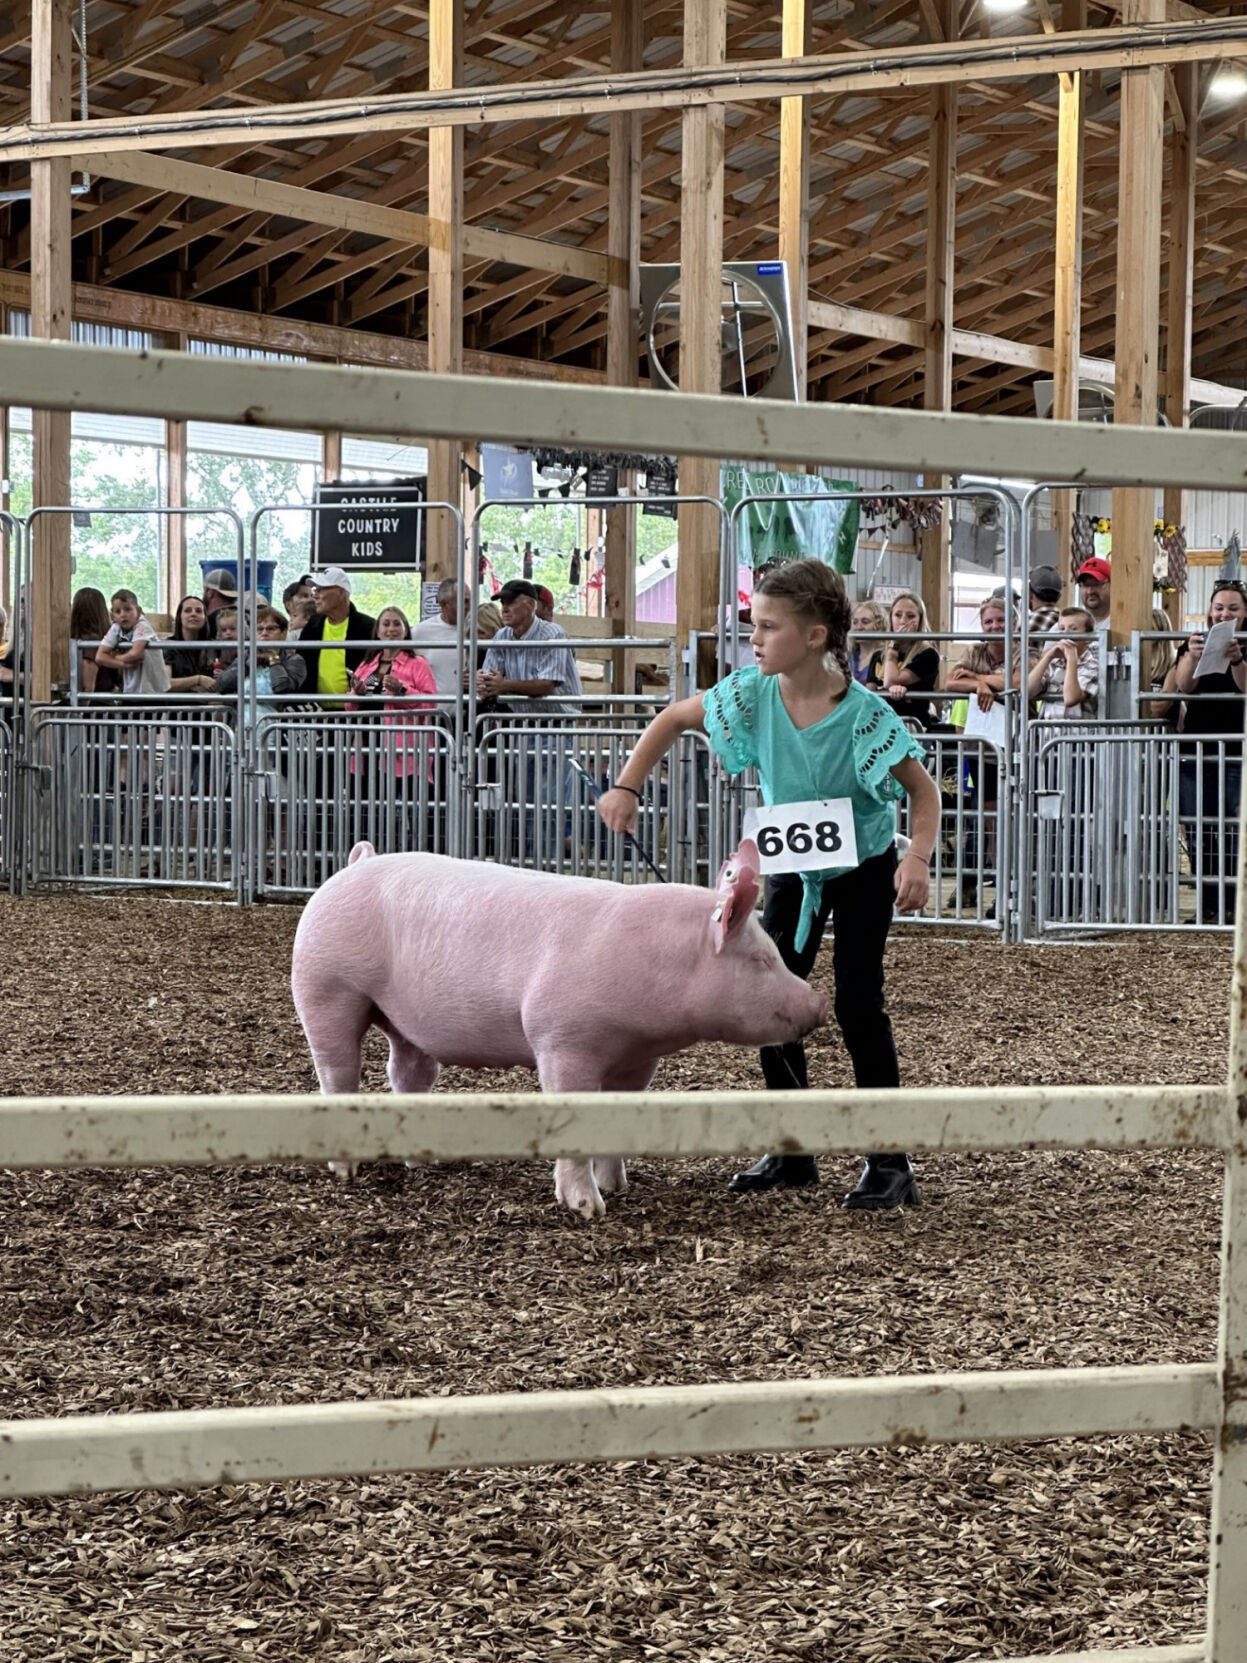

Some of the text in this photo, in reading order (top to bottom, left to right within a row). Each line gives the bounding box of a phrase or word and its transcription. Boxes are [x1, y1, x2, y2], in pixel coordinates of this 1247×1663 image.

[338, 518, 399, 534] COUNTRY
[351, 541, 383, 557] KIDS
[757, 821, 842, 857] 668
